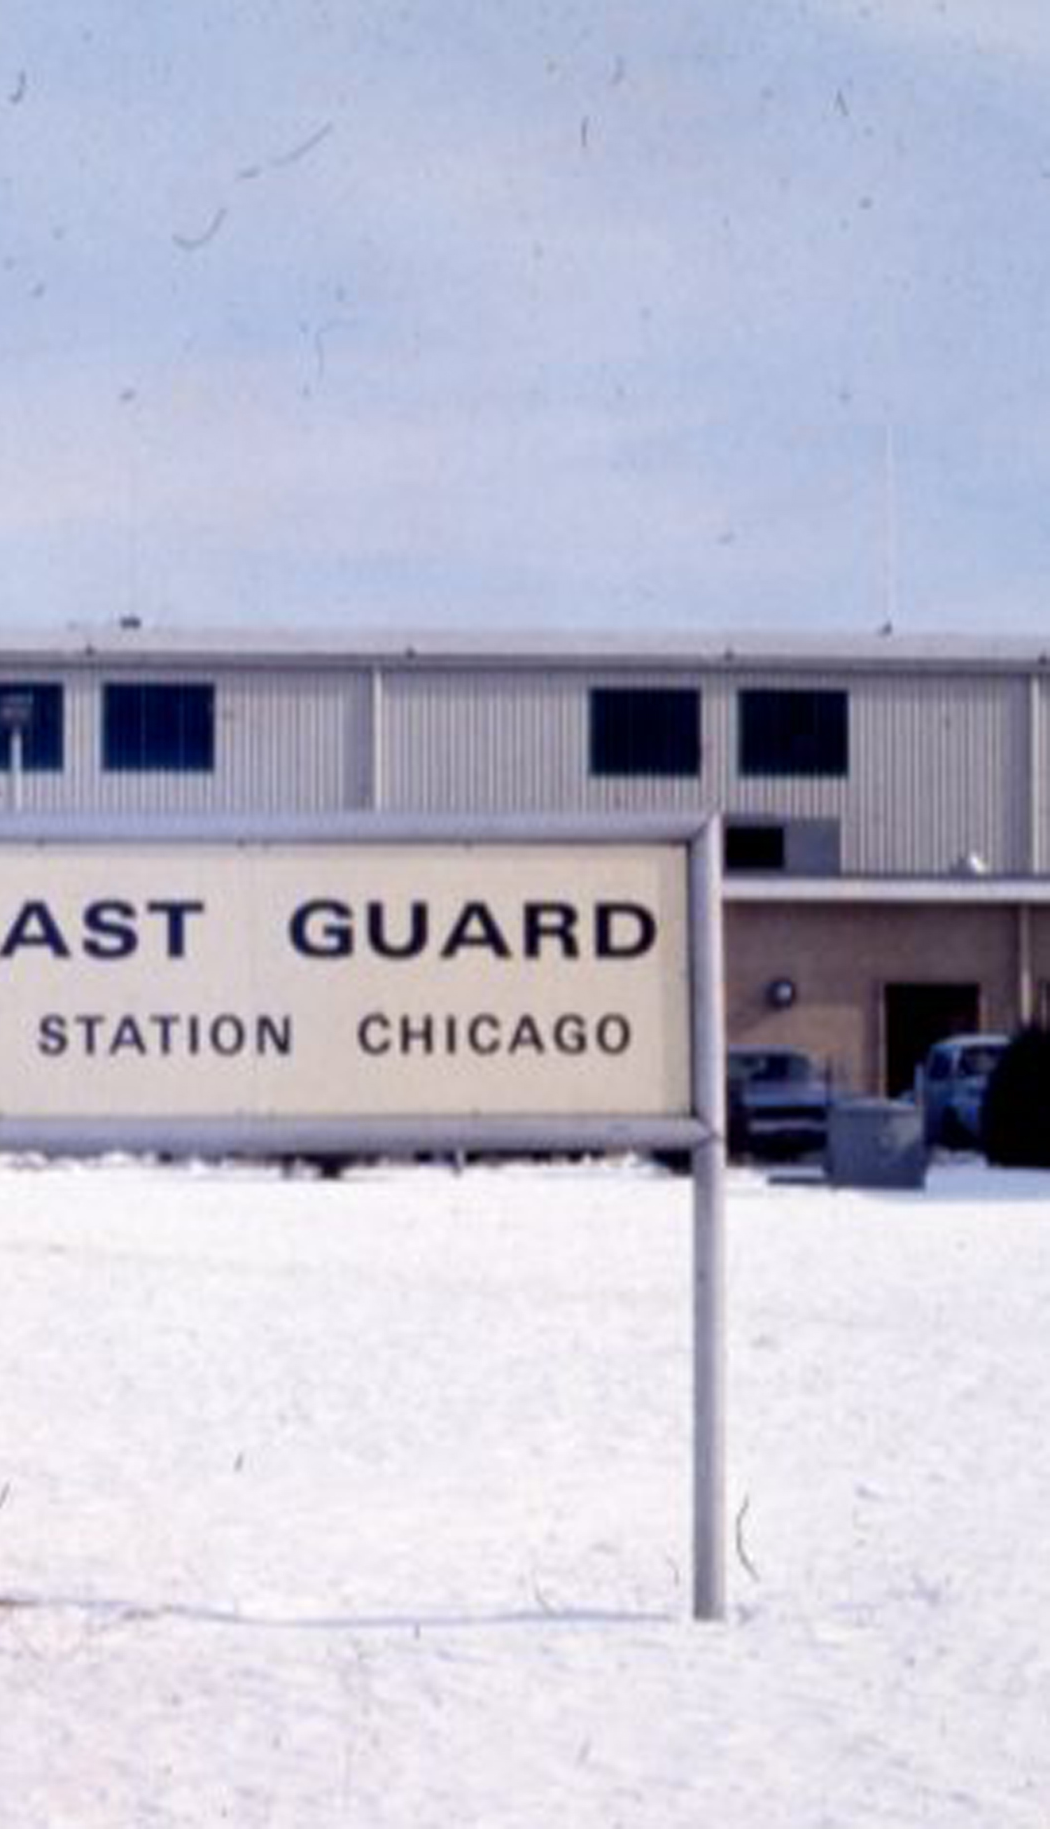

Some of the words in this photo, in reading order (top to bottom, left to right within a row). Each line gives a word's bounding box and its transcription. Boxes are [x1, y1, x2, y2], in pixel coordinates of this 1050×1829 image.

[288, 898, 658, 961] GUARD
[37, 1014, 292, 1056] STATION
[357, 1012, 632, 1056] CHICAGO
